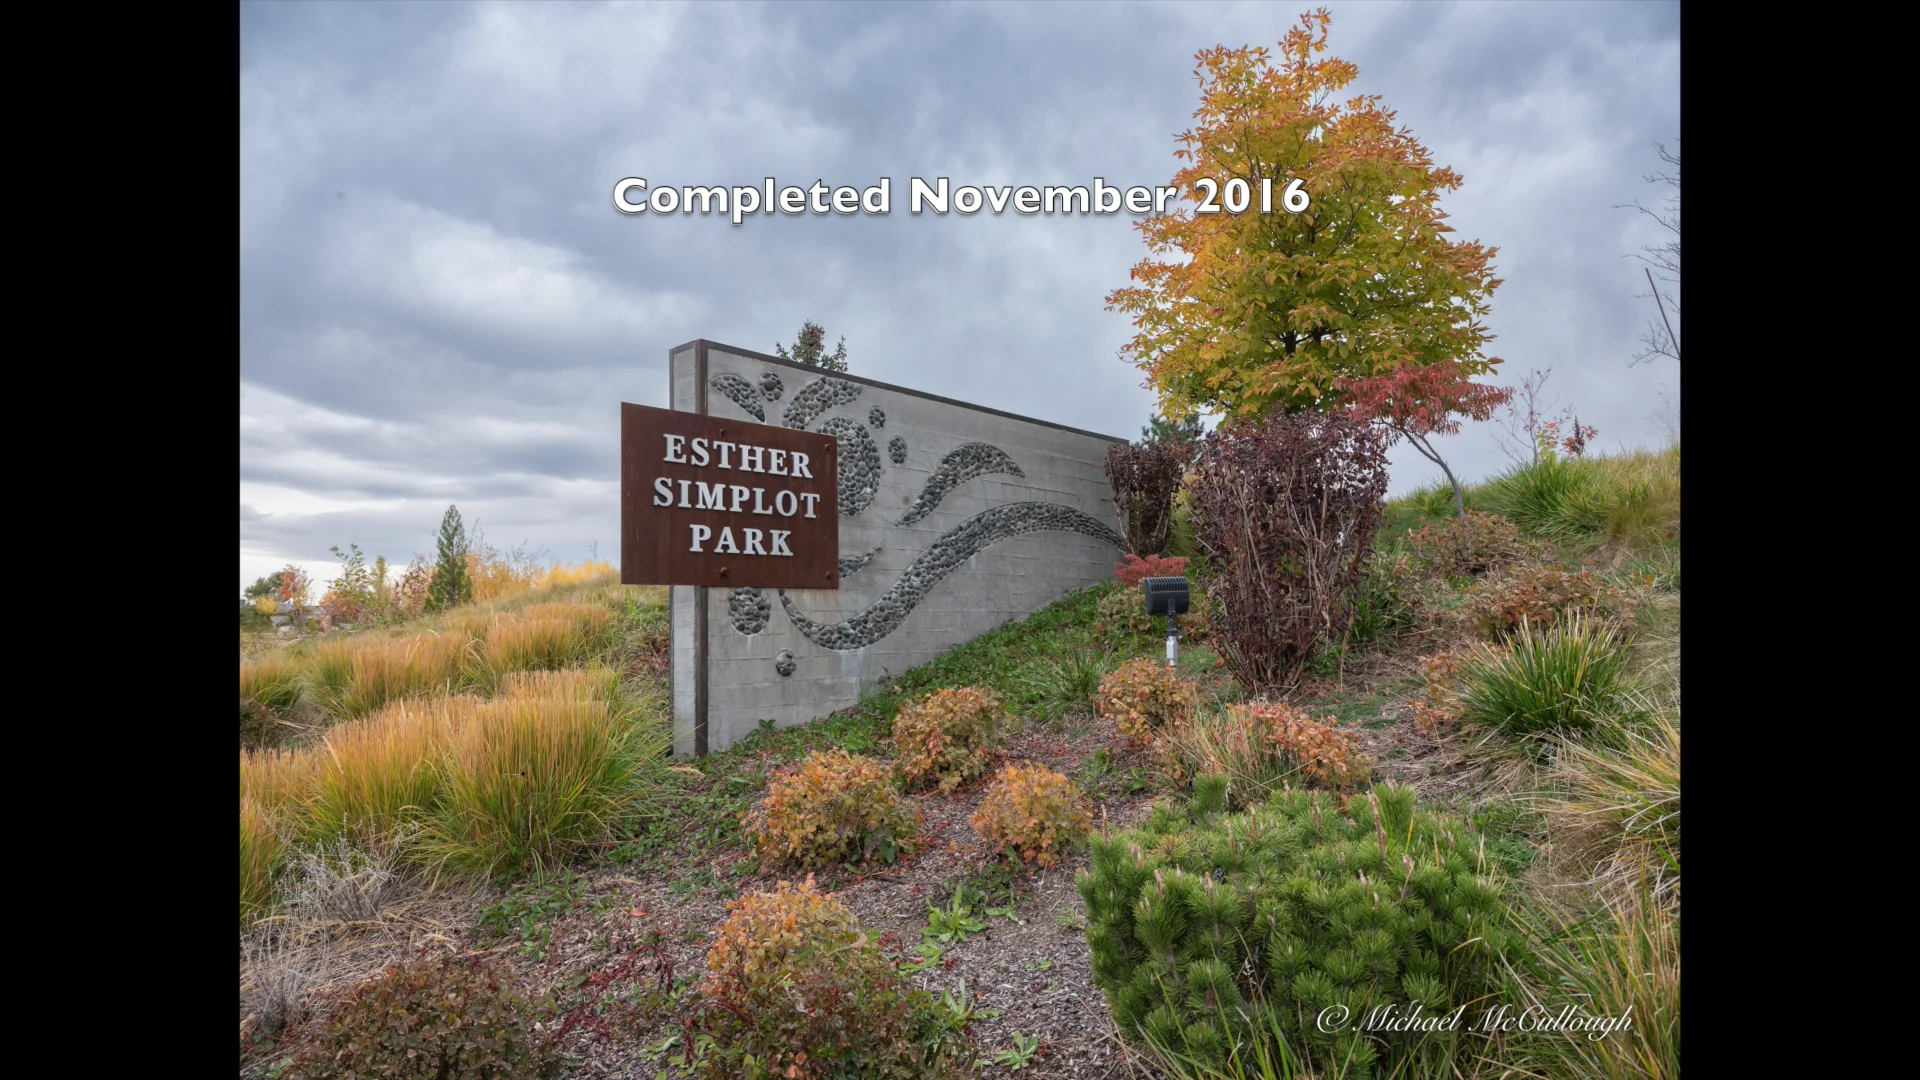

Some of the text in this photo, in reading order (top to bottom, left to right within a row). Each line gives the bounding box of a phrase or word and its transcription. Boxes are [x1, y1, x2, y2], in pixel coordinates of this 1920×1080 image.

[663, 433, 813, 479] ESTHER
[653, 476, 820, 519] SIMPLOT
[689, 523, 793, 557] PARK
